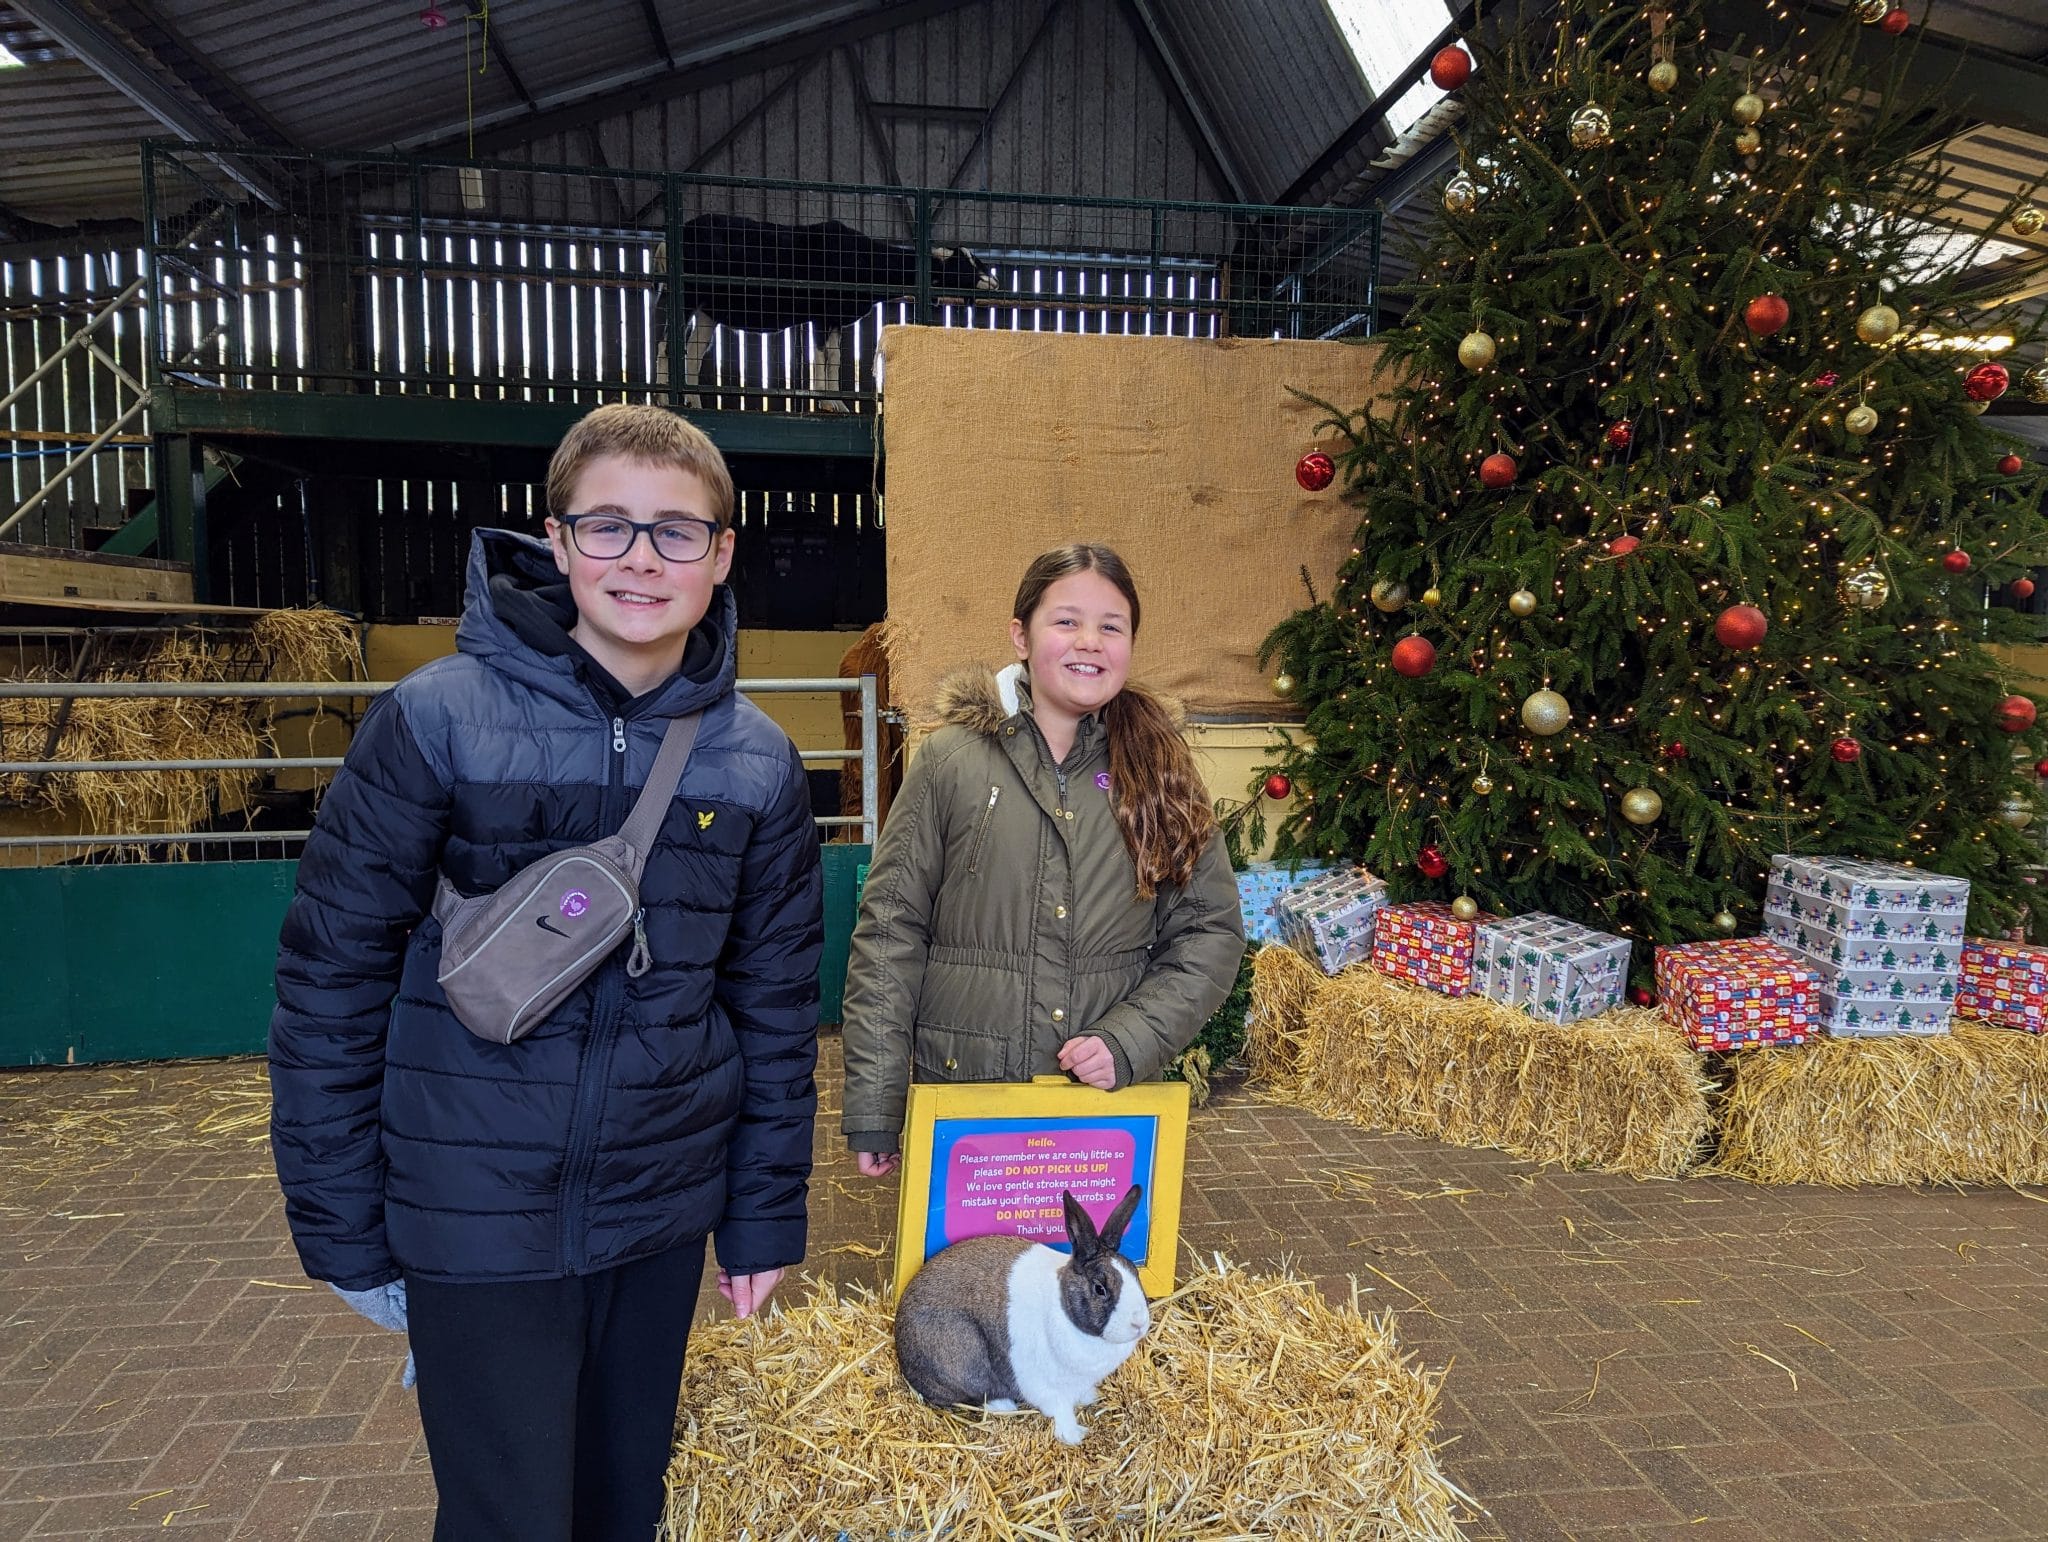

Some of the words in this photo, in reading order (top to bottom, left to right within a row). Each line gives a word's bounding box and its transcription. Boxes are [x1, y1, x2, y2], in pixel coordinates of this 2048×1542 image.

[959, 1154, 989, 1164] Please
[991, 1152, 1036, 1162] remember
[1052, 1152, 1067, 1160] are
[1069, 1150, 1088, 1161] only
[1090, 1150, 1113, 1159] little
[1114, 1151, 1125, 1159] so
[974, 1167, 1003, 1180] please
[1005, 1166, 1020, 1176] DO
[1023, 1165, 1045, 1175] NOT
[1047, 1164, 1072, 1174] PICK
[1074, 1164, 1088, 1173] US
[1091, 1163, 1108, 1173] UP!
[966, 1182, 981, 1192] We
[983, 1182, 1003, 1191] love
[1005, 1180, 1034, 1191] gentle
[1036, 1179, 1069, 1189] strokes
[1070, 1179, 1088, 1188] and
[1090, 1178, 1116, 1189] might
[961, 1196, 997, 1207] mistake
[999, 1197, 1021, 1207] your
[1023, 1194, 1054, 1205] fingers
[1105, 1192, 1116, 1201] so
[996, 1210, 1012, 1221] DO
[1014, 1209, 1037, 1220] NOT
[1039, 1208, 1064, 1218] FEED
[1016, 1224, 1044, 1234] Thank
[1046, 1225, 1066, 1235] you.
